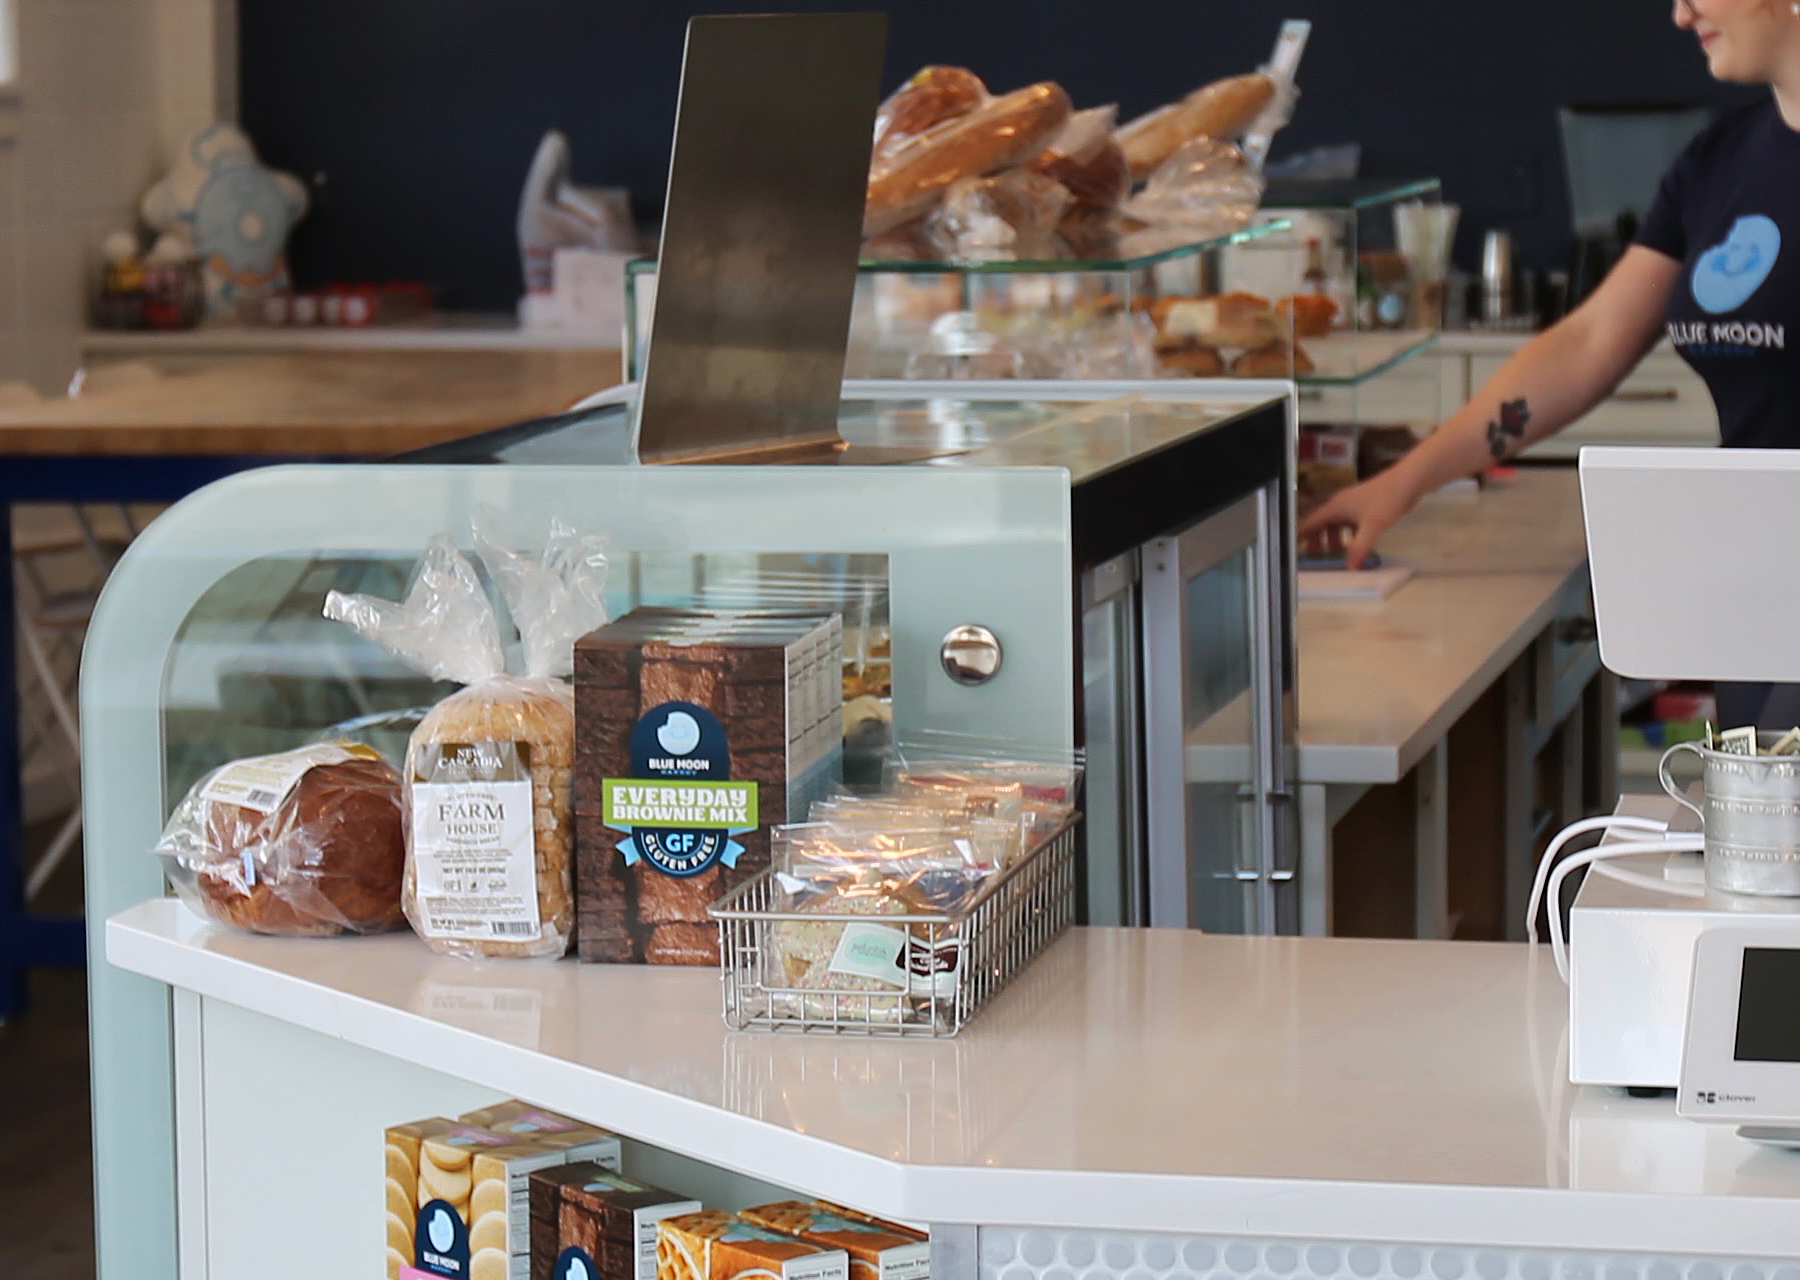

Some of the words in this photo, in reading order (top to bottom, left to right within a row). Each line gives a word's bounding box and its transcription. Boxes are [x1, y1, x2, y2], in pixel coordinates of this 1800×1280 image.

[1713, 323, 1786, 350] MOON
[438, 757, 504, 769] CASCADIA
[456, 748, 484, 760] NEW
[648, 758, 675, 770] BLUE
[676, 759, 710, 771] MOON
[612, 786, 748, 807] EVERYDAY
[439, 803, 506, 821] FARM
[612, 805, 705, 822] BROWNIE
[710, 808, 748, 823] MIX
[447, 823, 498, 835] HOUSE
[665, 833, 695, 852] GF
[645, 834, 688, 870] GLUTEN
[692, 835, 715, 868] FREE
[422, 1251, 439, 1265] BLUE
[439, 1255, 460, 1271] MOON
[789, 1272, 820, 1280] Nutrition
[821, 1268, 842, 1278] Facts
